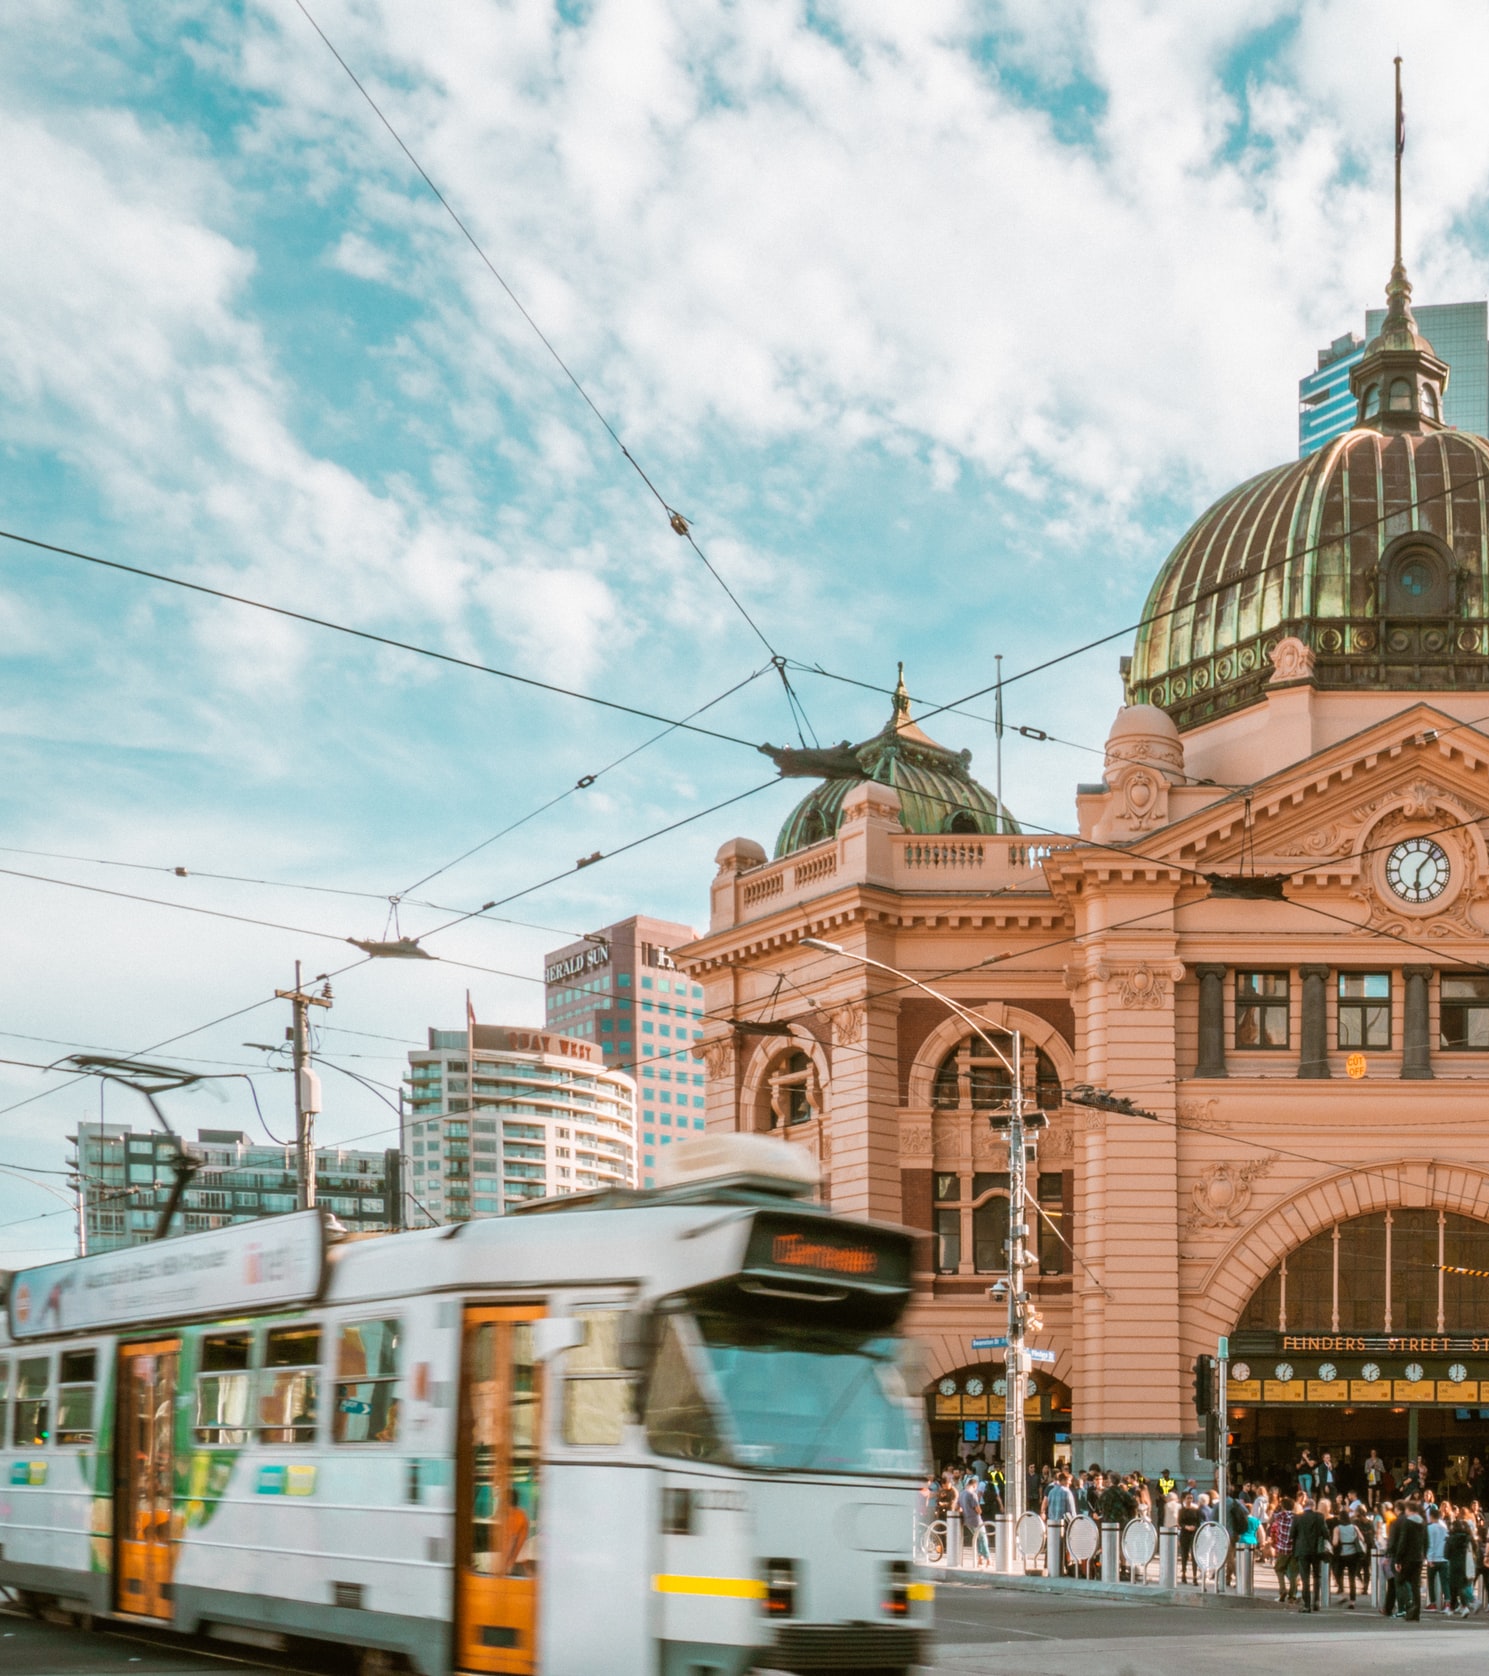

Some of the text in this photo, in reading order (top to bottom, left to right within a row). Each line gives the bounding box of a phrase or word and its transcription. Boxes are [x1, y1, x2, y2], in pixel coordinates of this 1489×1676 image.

[545, 946, 609, 982] HERALD SUN
[508, 1032, 591, 1061] QUAY WEST
[1347, 1056, 1363, 1066] CUT
[1349, 1067, 1364, 1076] OFF
[1283, 1336, 1366, 1351] FLINDERS
[1387, 1337, 1451, 1352] STREET
